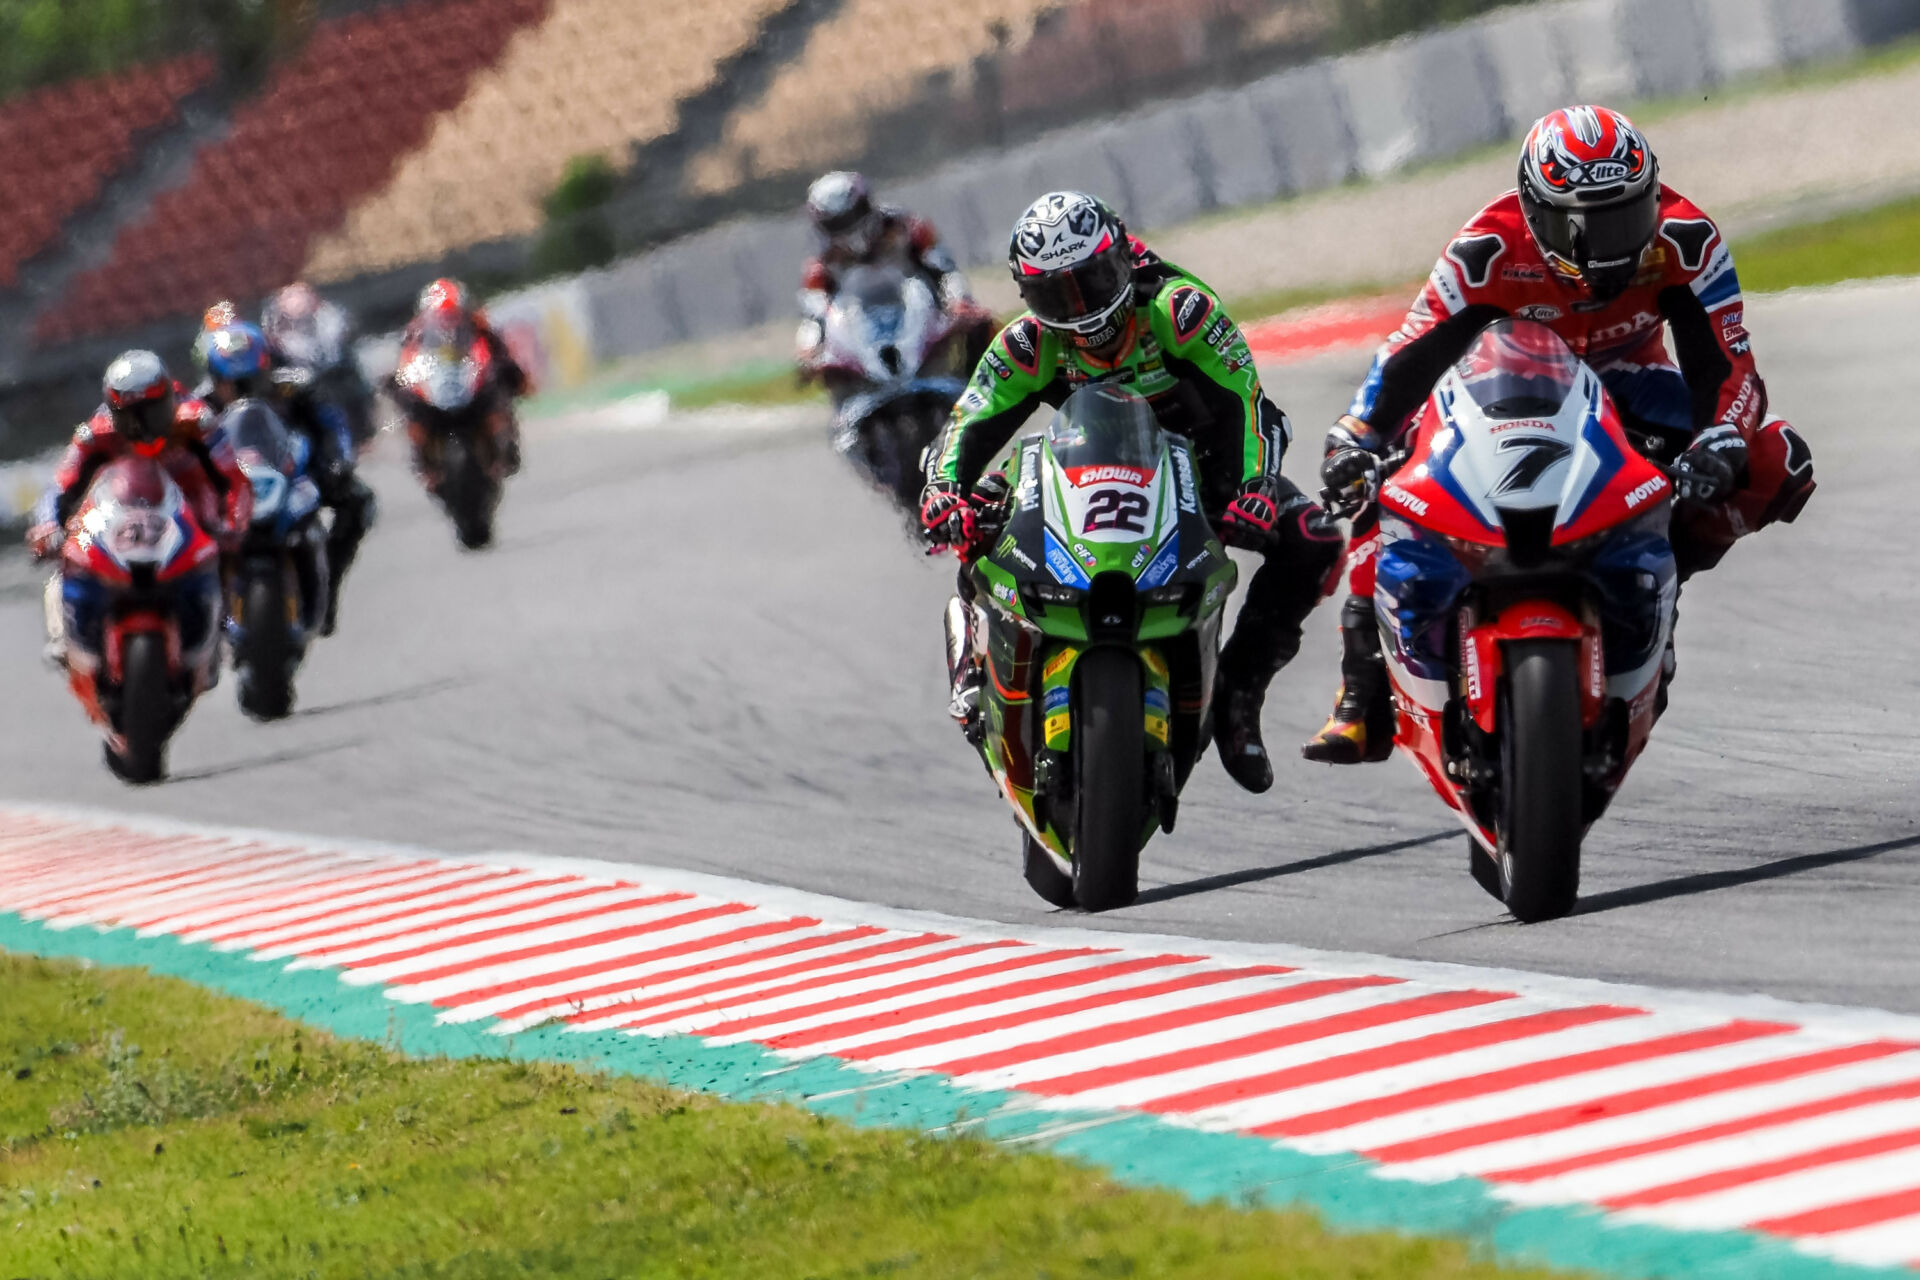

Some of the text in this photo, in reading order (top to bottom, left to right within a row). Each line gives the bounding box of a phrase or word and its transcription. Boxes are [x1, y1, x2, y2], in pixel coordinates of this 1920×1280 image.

[1574, 162, 1625, 184] X-lite
[1041, 240, 1087, 262] SHARK
[1177, 290, 1201, 331] RST
[1207, 320, 1224, 345] elf
[985, 351, 1001, 370] elf
[1489, 419, 1556, 435] HONDA
[1079, 466, 1144, 485] SHOWA
[1484, 433, 1575, 499] 7
[1170, 444, 1197, 515] Kawasaki
[1624, 475, 1668, 509] MOTUL
[1081, 488, 1151, 535] 22
[1384, 484, 1430, 517] MOTUL
[1073, 542, 1091, 559] elf
[1131, 551, 1145, 568] elf
[1466, 635, 1483, 701] PIRELLI
